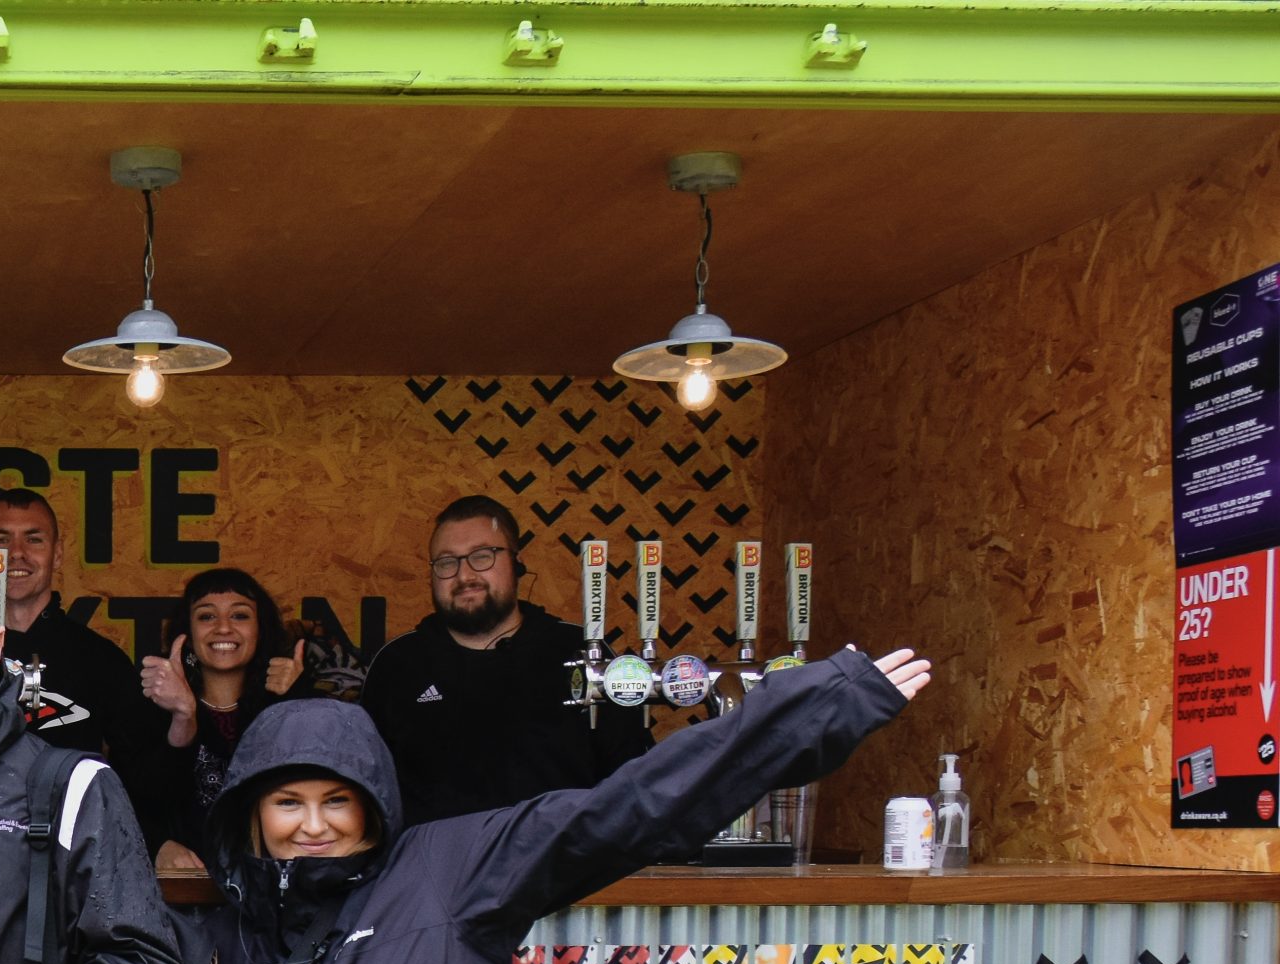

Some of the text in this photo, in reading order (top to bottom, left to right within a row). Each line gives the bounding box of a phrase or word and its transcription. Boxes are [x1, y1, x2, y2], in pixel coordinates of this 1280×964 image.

[1186, 327, 1264, 364] REUSABLE CUPS
[1189, 357, 1259, 390] HOW IT WORKS
[1194, 400, 1209, 411] BUY
[1211, 393, 1230, 404] YOUR
[1231, 385, 1253, 399] DRINK
[1190, 432, 1214, 445] ENJOY
[1215, 425, 1234, 437] YOUR
[1235, 417, 1257, 431] DRINK
[1192, 465, 1220, 480] RETURN
[1221, 459, 1241, 471] YOUR
[1241, 454, 1257, 466] CUP
[1201, 503, 1218, 514] TAKE
[1219, 499, 1236, 509] YOUR
[1237, 495, 1251, 505] CUP
[1251, 489, 1272, 501] HOME
[588, 544, 605, 566] B
[643, 543, 660, 566] B
[742, 544, 759, 566] B
[795, 546, 812, 568] B
[591, 572, 601, 622] BRIXTON
[646, 571, 656, 622] BRIXTON
[744, 572, 755, 622] BRIXTON
[1180, 565, 1249, 607] UNDER
[798, 574, 808, 624] BRIXTON
[1179, 607, 1212, 641] 25?
[1178, 651, 1218, 668] Please be
[611, 682, 647, 690] BRIXTON
[669, 680, 704, 692] BRIXTON
[1177, 666, 1251, 688] prepared to show
[416, 694, 443, 703] adidas
[1177, 684, 1252, 704] proof of age when
[1177, 703, 1237, 722] buying alcohol
